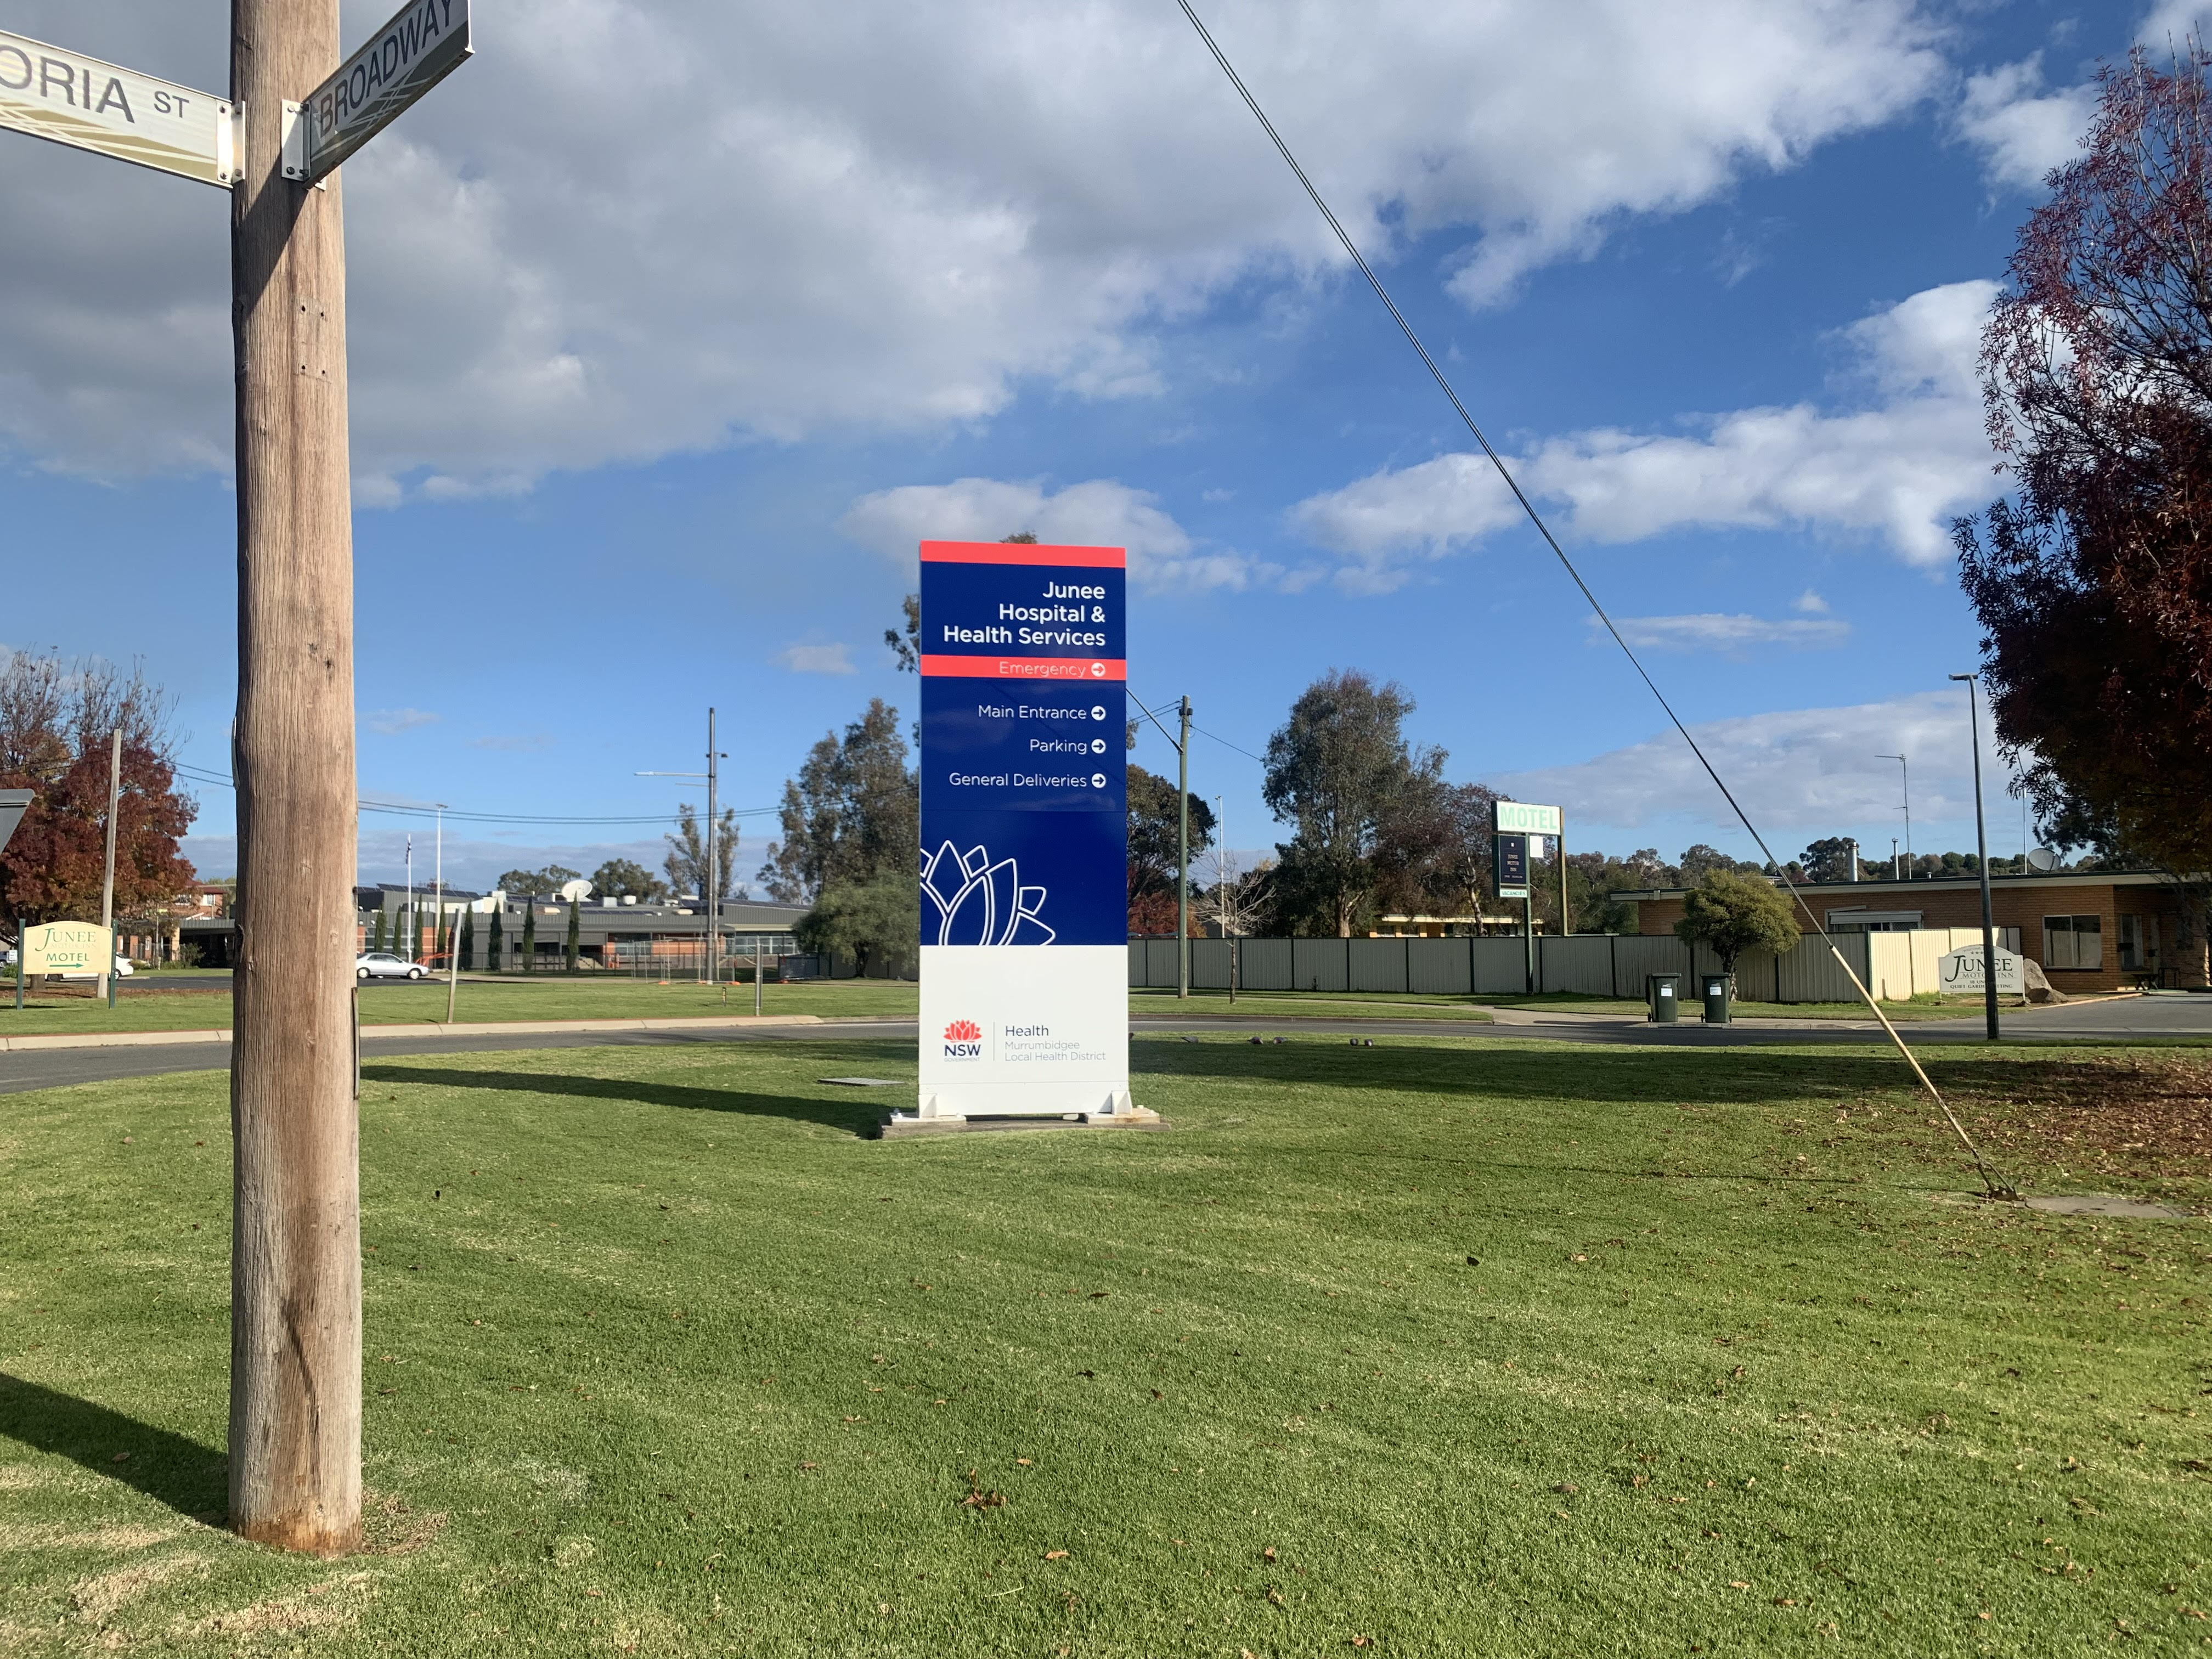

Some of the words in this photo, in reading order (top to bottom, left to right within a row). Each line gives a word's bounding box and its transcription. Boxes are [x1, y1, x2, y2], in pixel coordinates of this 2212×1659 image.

[320, 0, 450, 139] BROADWAY
[154, 91, 190, 119] ST
[1042, 582, 1105, 600] Junee
[999, 603, 1085, 624] Hospital
[1091, 606, 1105, 623] &
[944, 625, 1012, 644] Health
[1018, 628, 1105, 646] Services
[999, 661, 1086, 678] Emergency
[978, 705, 1014, 718] Main
[1019, 706, 1087, 720] Entrance
[1030, 739, 1087, 755] Parking
[949, 772, 1008, 786] General
[1013, 772, 1087, 787] Deliveries
[1500, 806, 1557, 829] MOTEL
[35, 928, 96, 951] JUNEE
[46, 953, 90, 961] MOTEL
[1005, 1025, 1049, 1036] Health
[945, 1044, 981, 1057] NSW
[1005, 1041, 1080, 1052] Murrumbidgee
[1005, 1052, 1032, 1061] Local
[1035, 1052, 1068, 1061] Health
[1070, 1051, 1106, 1061] District
